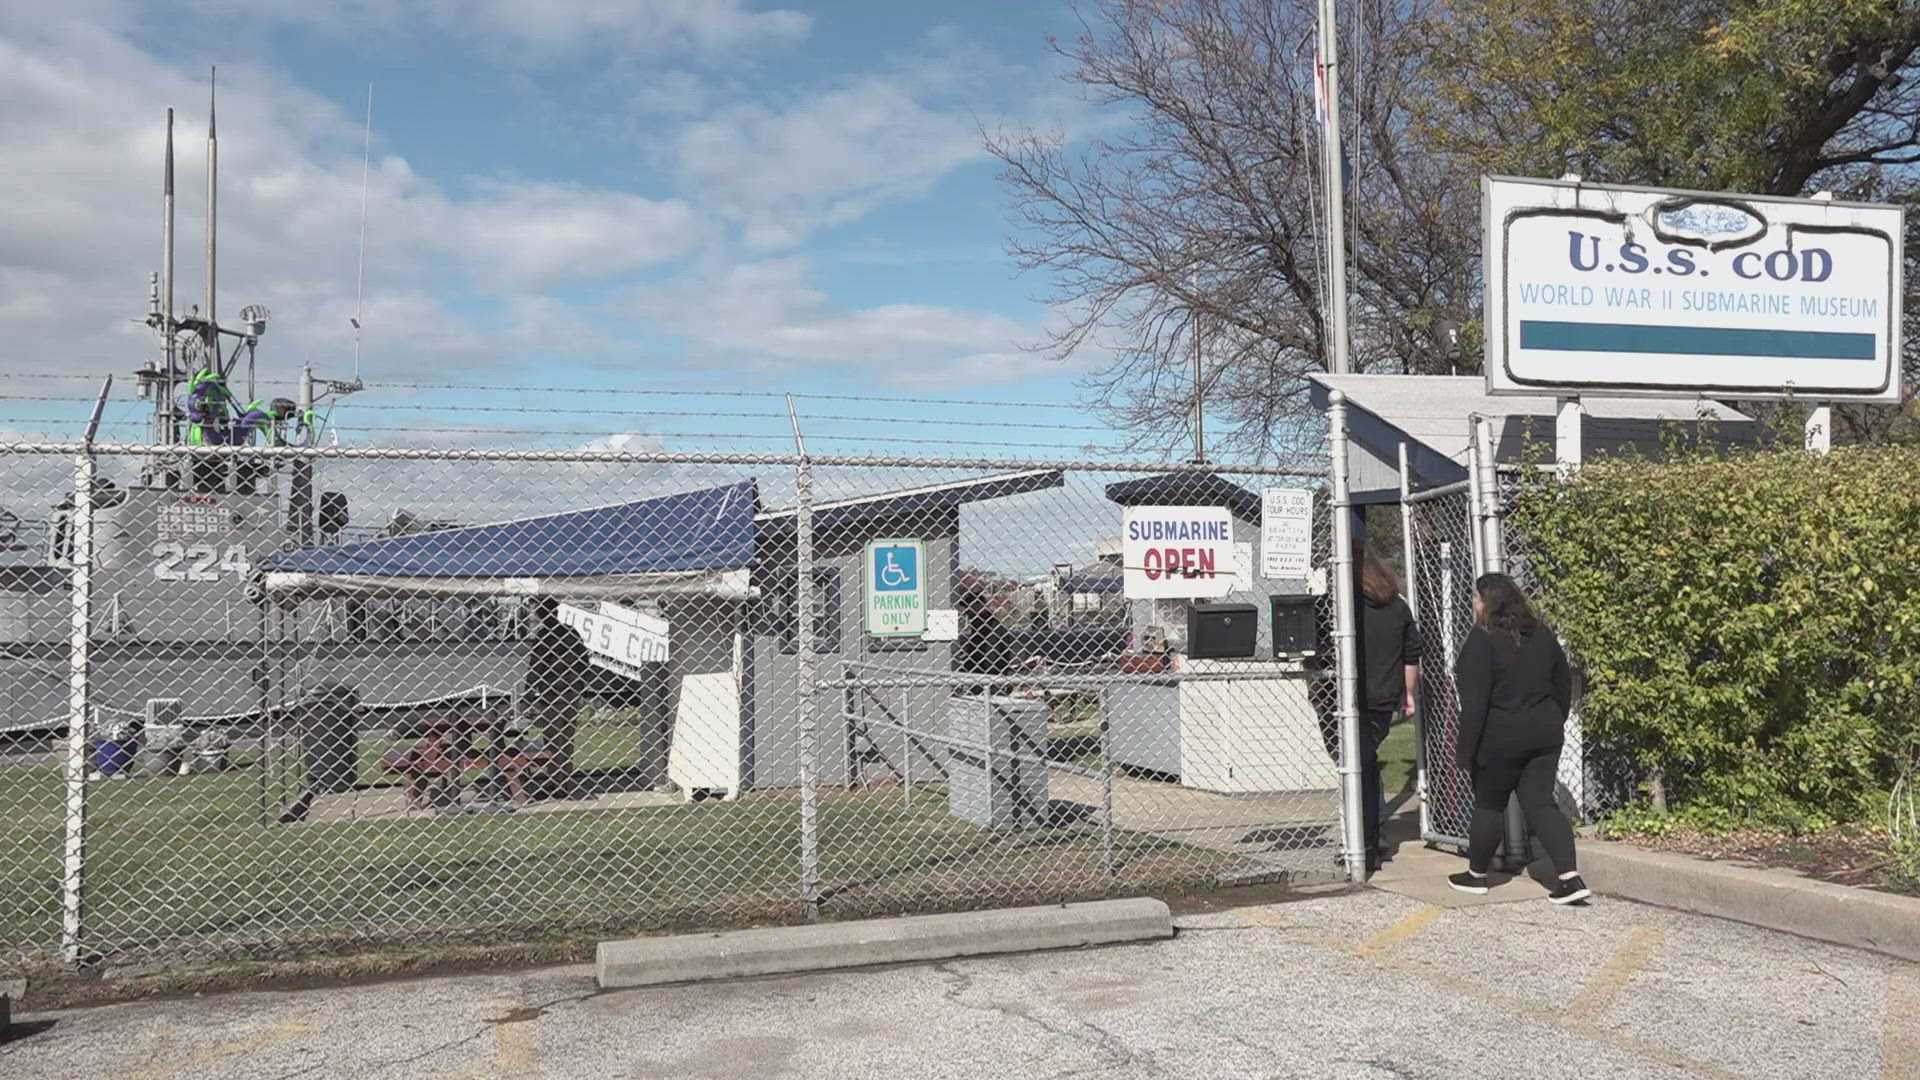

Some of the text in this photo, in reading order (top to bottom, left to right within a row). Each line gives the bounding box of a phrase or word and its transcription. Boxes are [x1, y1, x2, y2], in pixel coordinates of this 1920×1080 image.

[1569, 231, 1833, 283] U.S.S. COD
[1519, 282, 1878, 318] WORLD WAR II SUBMARINE MUSEUM
[1266, 505, 1309, 516] TOUR HOURS
[1129, 520, 1229, 541] SUBMARINE
[152, 543, 251, 581] 224
[1143, 547, 1216, 580] OPEN
[873, 594, 919, 610] PARKING
[882, 612, 911, 626] ONLY
[626, 632, 667, 662] COD
